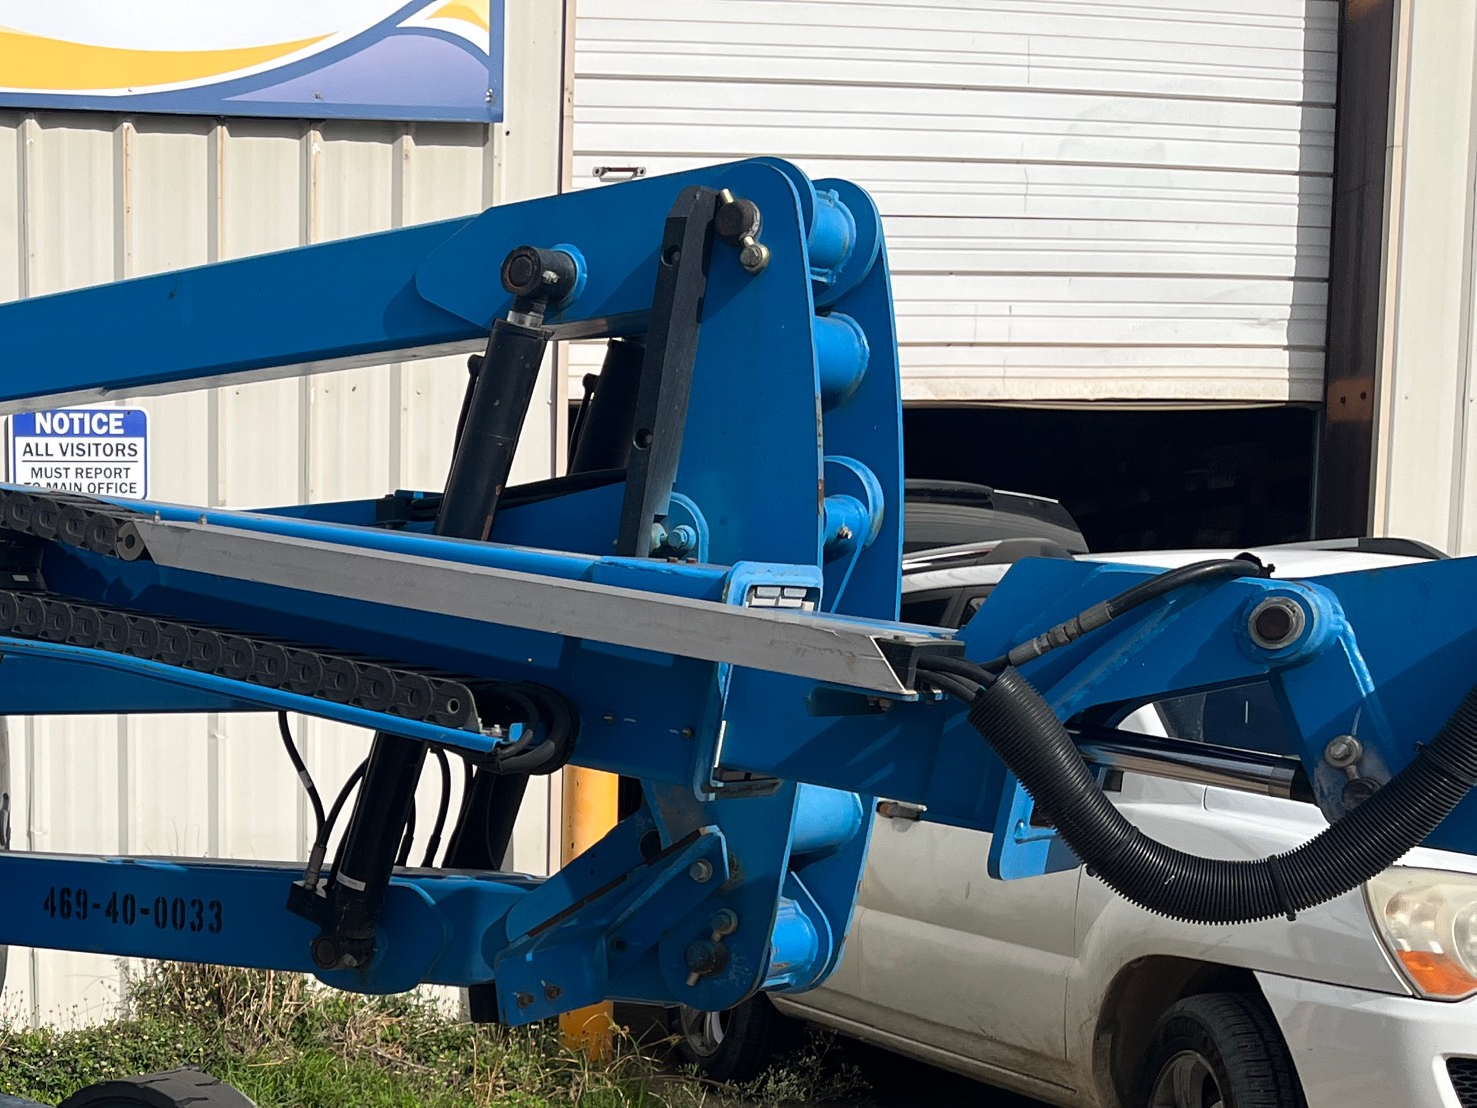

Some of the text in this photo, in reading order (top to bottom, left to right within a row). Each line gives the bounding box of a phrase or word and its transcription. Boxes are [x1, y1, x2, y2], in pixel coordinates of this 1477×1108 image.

[35, 412, 125, 435] NOTICE
[23, 443, 138, 457] ALL VISITORS
[30, 467, 131, 479] MUST REPORT
[87, 482, 137, 494] OFFICE
[43, 886, 224, 934] 469-40-0033
